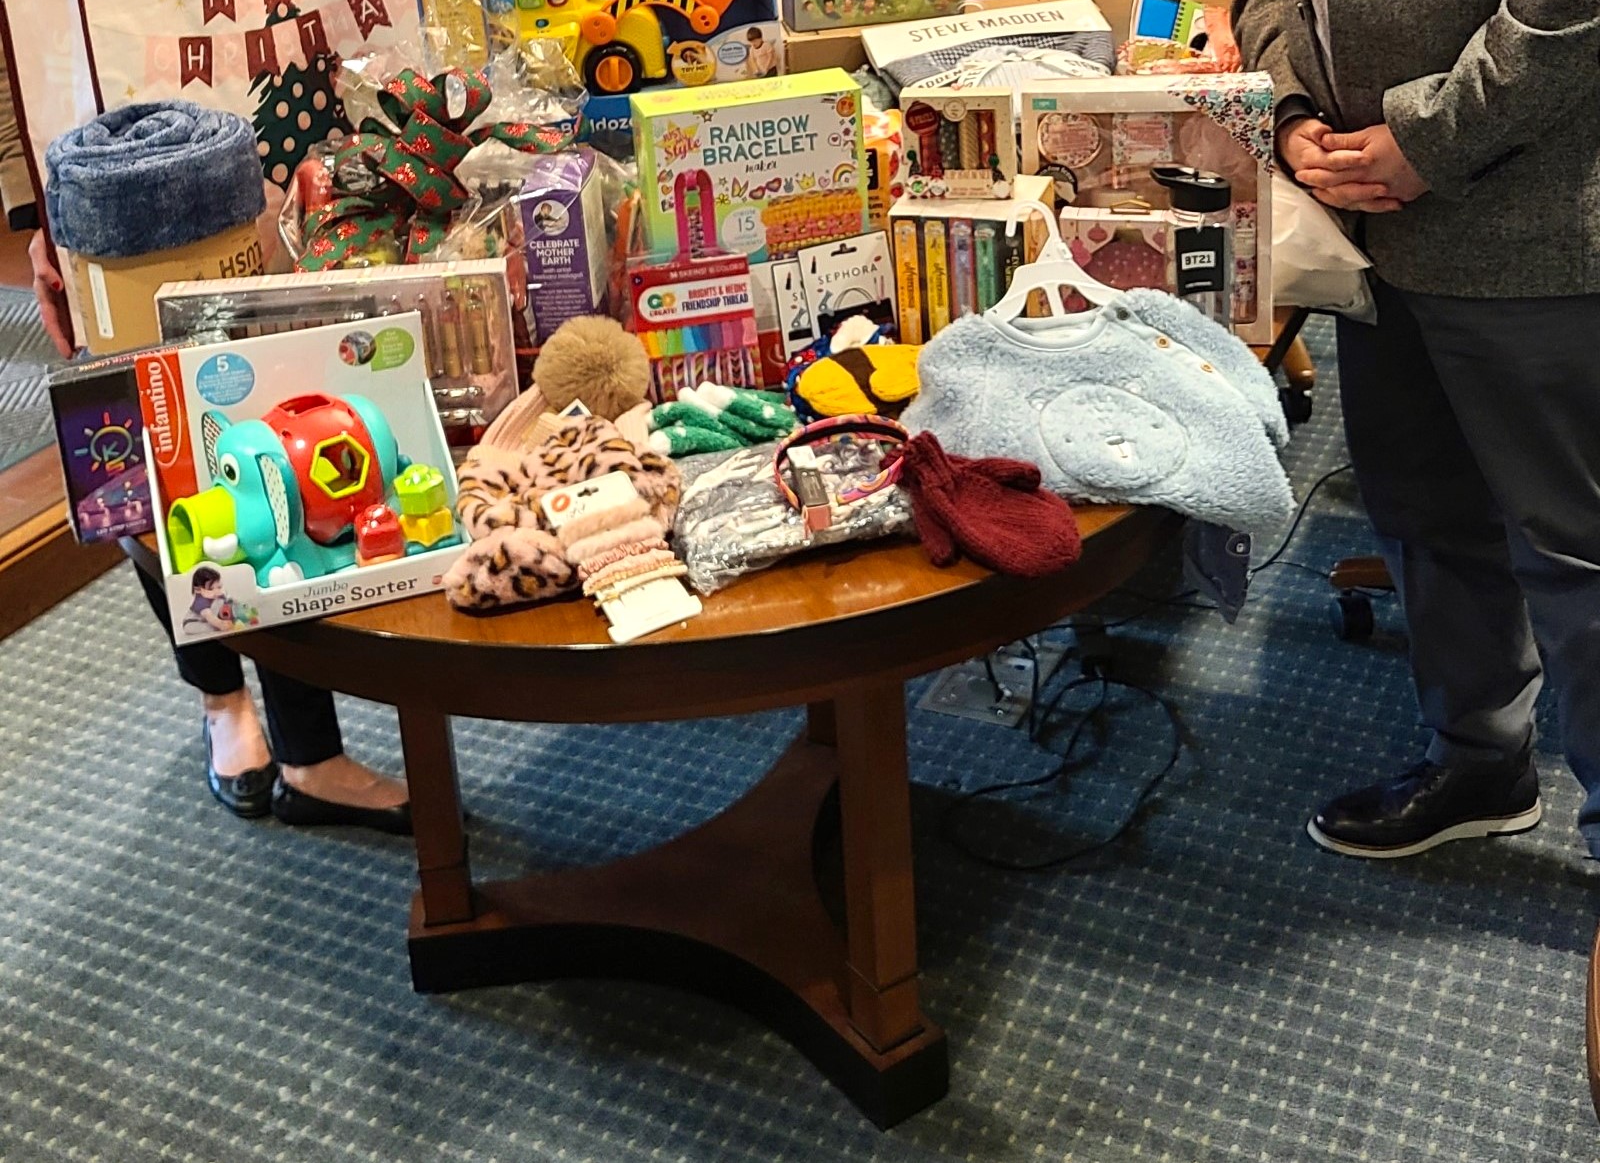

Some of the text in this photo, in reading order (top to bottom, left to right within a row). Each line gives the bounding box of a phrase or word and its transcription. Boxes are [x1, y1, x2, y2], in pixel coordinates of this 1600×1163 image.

[908, 10, 1065, 43] STEVE MADDEN
[709, 114, 810, 145] RAINBOW
[702, 133, 818, 166] BRACELET
[745, 159, 778, 174] maker
[738, 215, 756, 233] 15
[529, 238, 580, 250] CELEBRATE
[536, 248, 575, 258] MOTHER
[219, 240, 263, 279] LUSH
[541, 256, 572, 266] EARTH
[818, 263, 878, 285] SEPHORA
[681, 293, 749, 312] FRIENDSHIP THREAD
[147, 361, 174, 455] infantino
[281, 577, 418, 617] Shape Sorter
[303, 579, 349, 599] Jumbo
